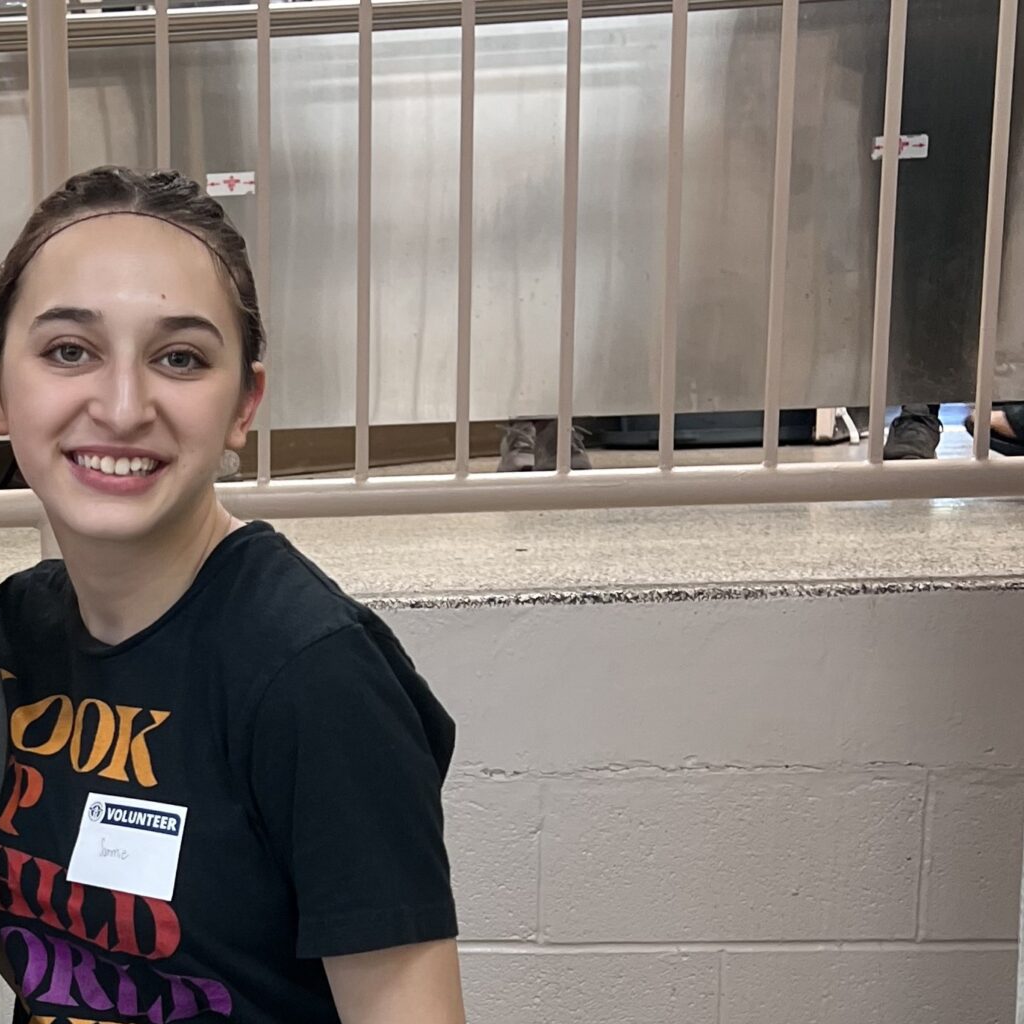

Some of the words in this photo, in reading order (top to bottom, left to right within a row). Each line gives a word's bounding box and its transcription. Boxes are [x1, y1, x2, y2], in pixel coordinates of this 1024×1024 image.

[0, 668, 171, 788] OOK
[107, 807, 178, 832] VOLUNTEER
[0, 926, 233, 1024] ORLD
